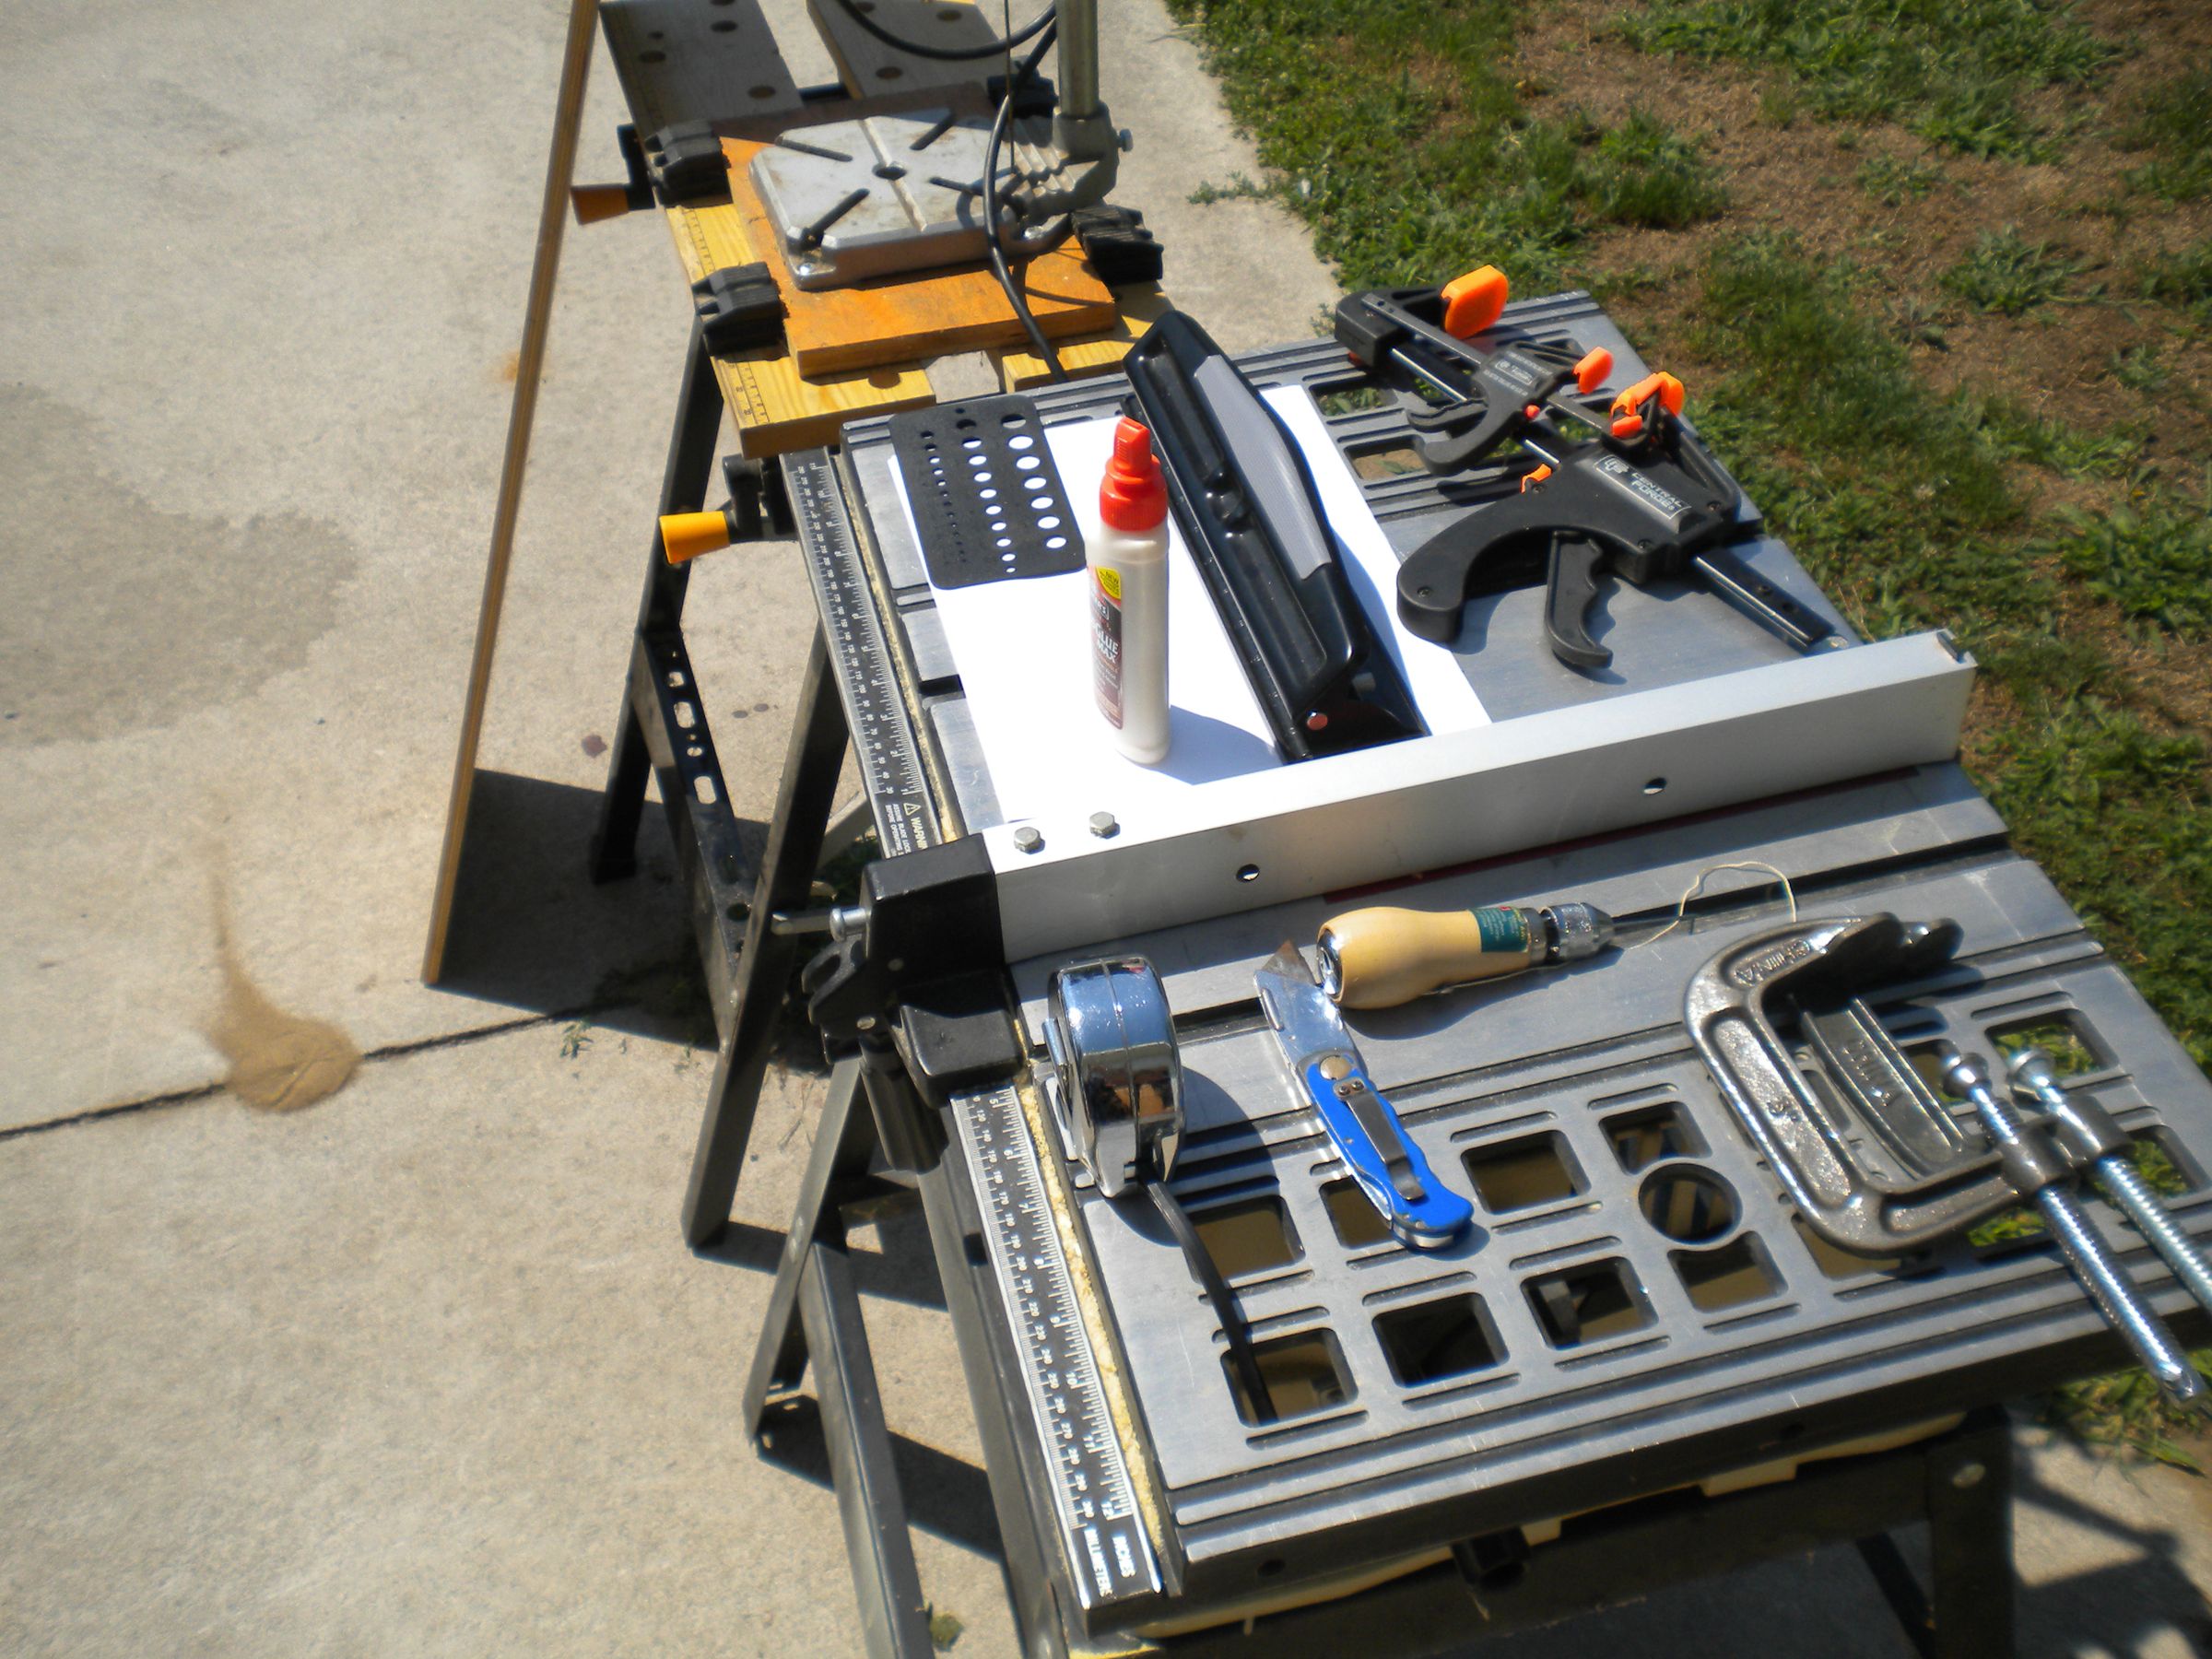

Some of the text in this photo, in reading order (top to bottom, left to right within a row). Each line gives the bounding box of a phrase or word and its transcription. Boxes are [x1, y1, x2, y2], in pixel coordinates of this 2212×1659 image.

[1630, 472, 1683, 508] CENTRAL
[1630, 479, 1671, 508] FORGE
[1096, 623, 1119, 655] GLUE
[1097, 638, 1118, 664] MAX
[882, 771, 890, 779] 40
[885, 805, 896, 823] BEFORE
[890, 823, 903, 851] OPERATING
[898, 822, 908, 839] BLADE
[998, 1191, 1009, 1206] 170
[1022, 1278, 1033, 1294] 210
[1047, 1371, 1060, 1389] 250
[1061, 1422, 1073, 1440] 270
[1082, 1500, 1095, 1518] 300
[1050, 1315, 1061, 1324] 9
[1065, 1371, 1077, 1385] 10
[1083, 1434, 1095, 1448] 11
[1100, 1500, 1114, 1517] 12
[1084, 1528, 1113, 1598] MILLIMETERS
[1112, 1535, 1136, 1578] INCHES
